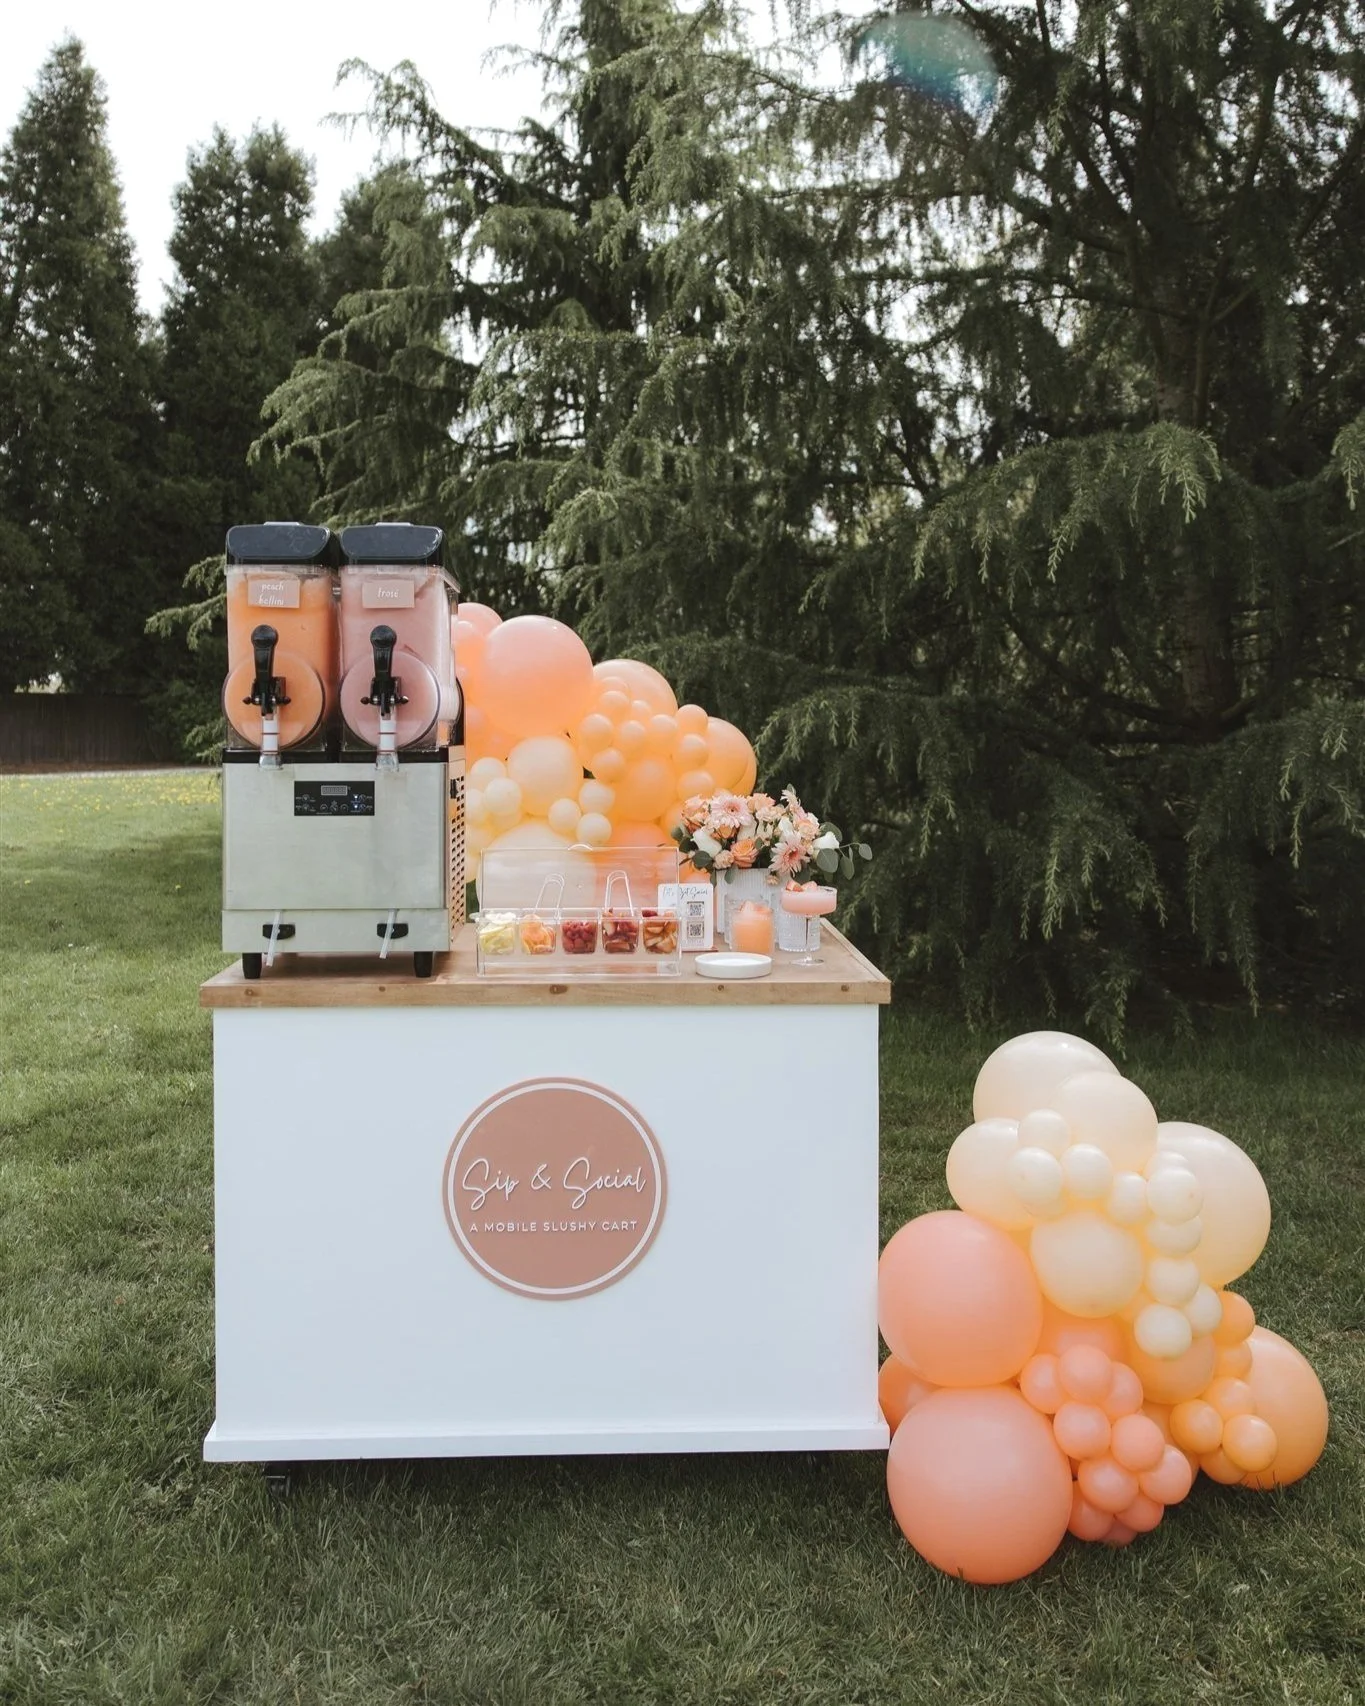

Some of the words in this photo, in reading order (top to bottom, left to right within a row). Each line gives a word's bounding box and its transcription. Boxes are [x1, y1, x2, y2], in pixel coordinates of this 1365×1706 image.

[462, 1158, 519, 1211] Sip
[531, 1163, 552, 1190] &
[563, 1156, 646, 1210] Social
[469, 1223, 478, 1232] A
[484, 1222, 537, 1232] MOBILE
[543, 1221, 596, 1232] SLUSHY
[601, 1220, 637, 1231] CART
